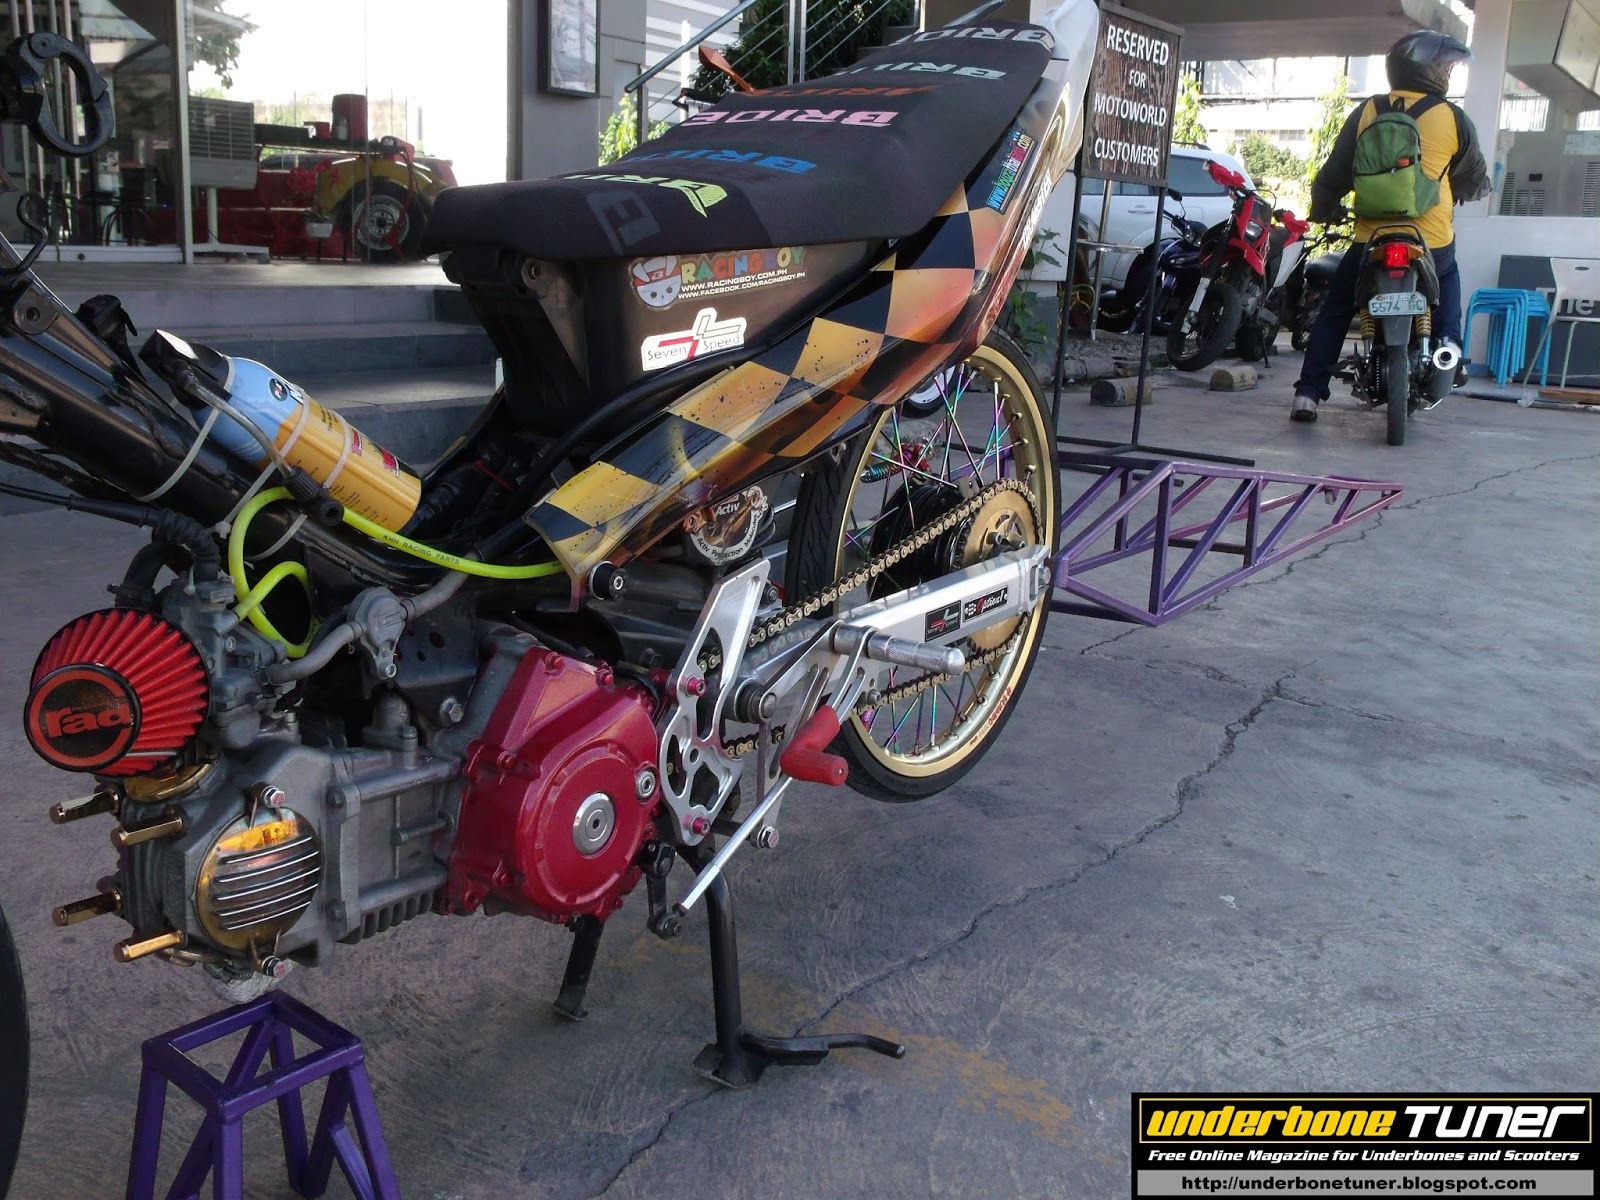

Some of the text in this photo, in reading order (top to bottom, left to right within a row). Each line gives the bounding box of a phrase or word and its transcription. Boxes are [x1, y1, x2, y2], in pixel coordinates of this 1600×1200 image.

[1106, 24, 1169, 67] RESERVED
[1128, 69, 1147, 89] FOR
[680, 109, 899, 127] BRIDE
[1094, 92, 1167, 127] MOTOWORLD
[1094, 137, 1159, 167] CUSTOMERS
[681, 268, 788, 293] WWW.RACINGBOY.COM.PH
[647, 346, 688, 361] Seven
[702, 333, 741, 353] Speed
[716, 501, 741, 517] Activ
[402, 541, 433, 557] RACING
[435, 553, 460, 565] PARTS
